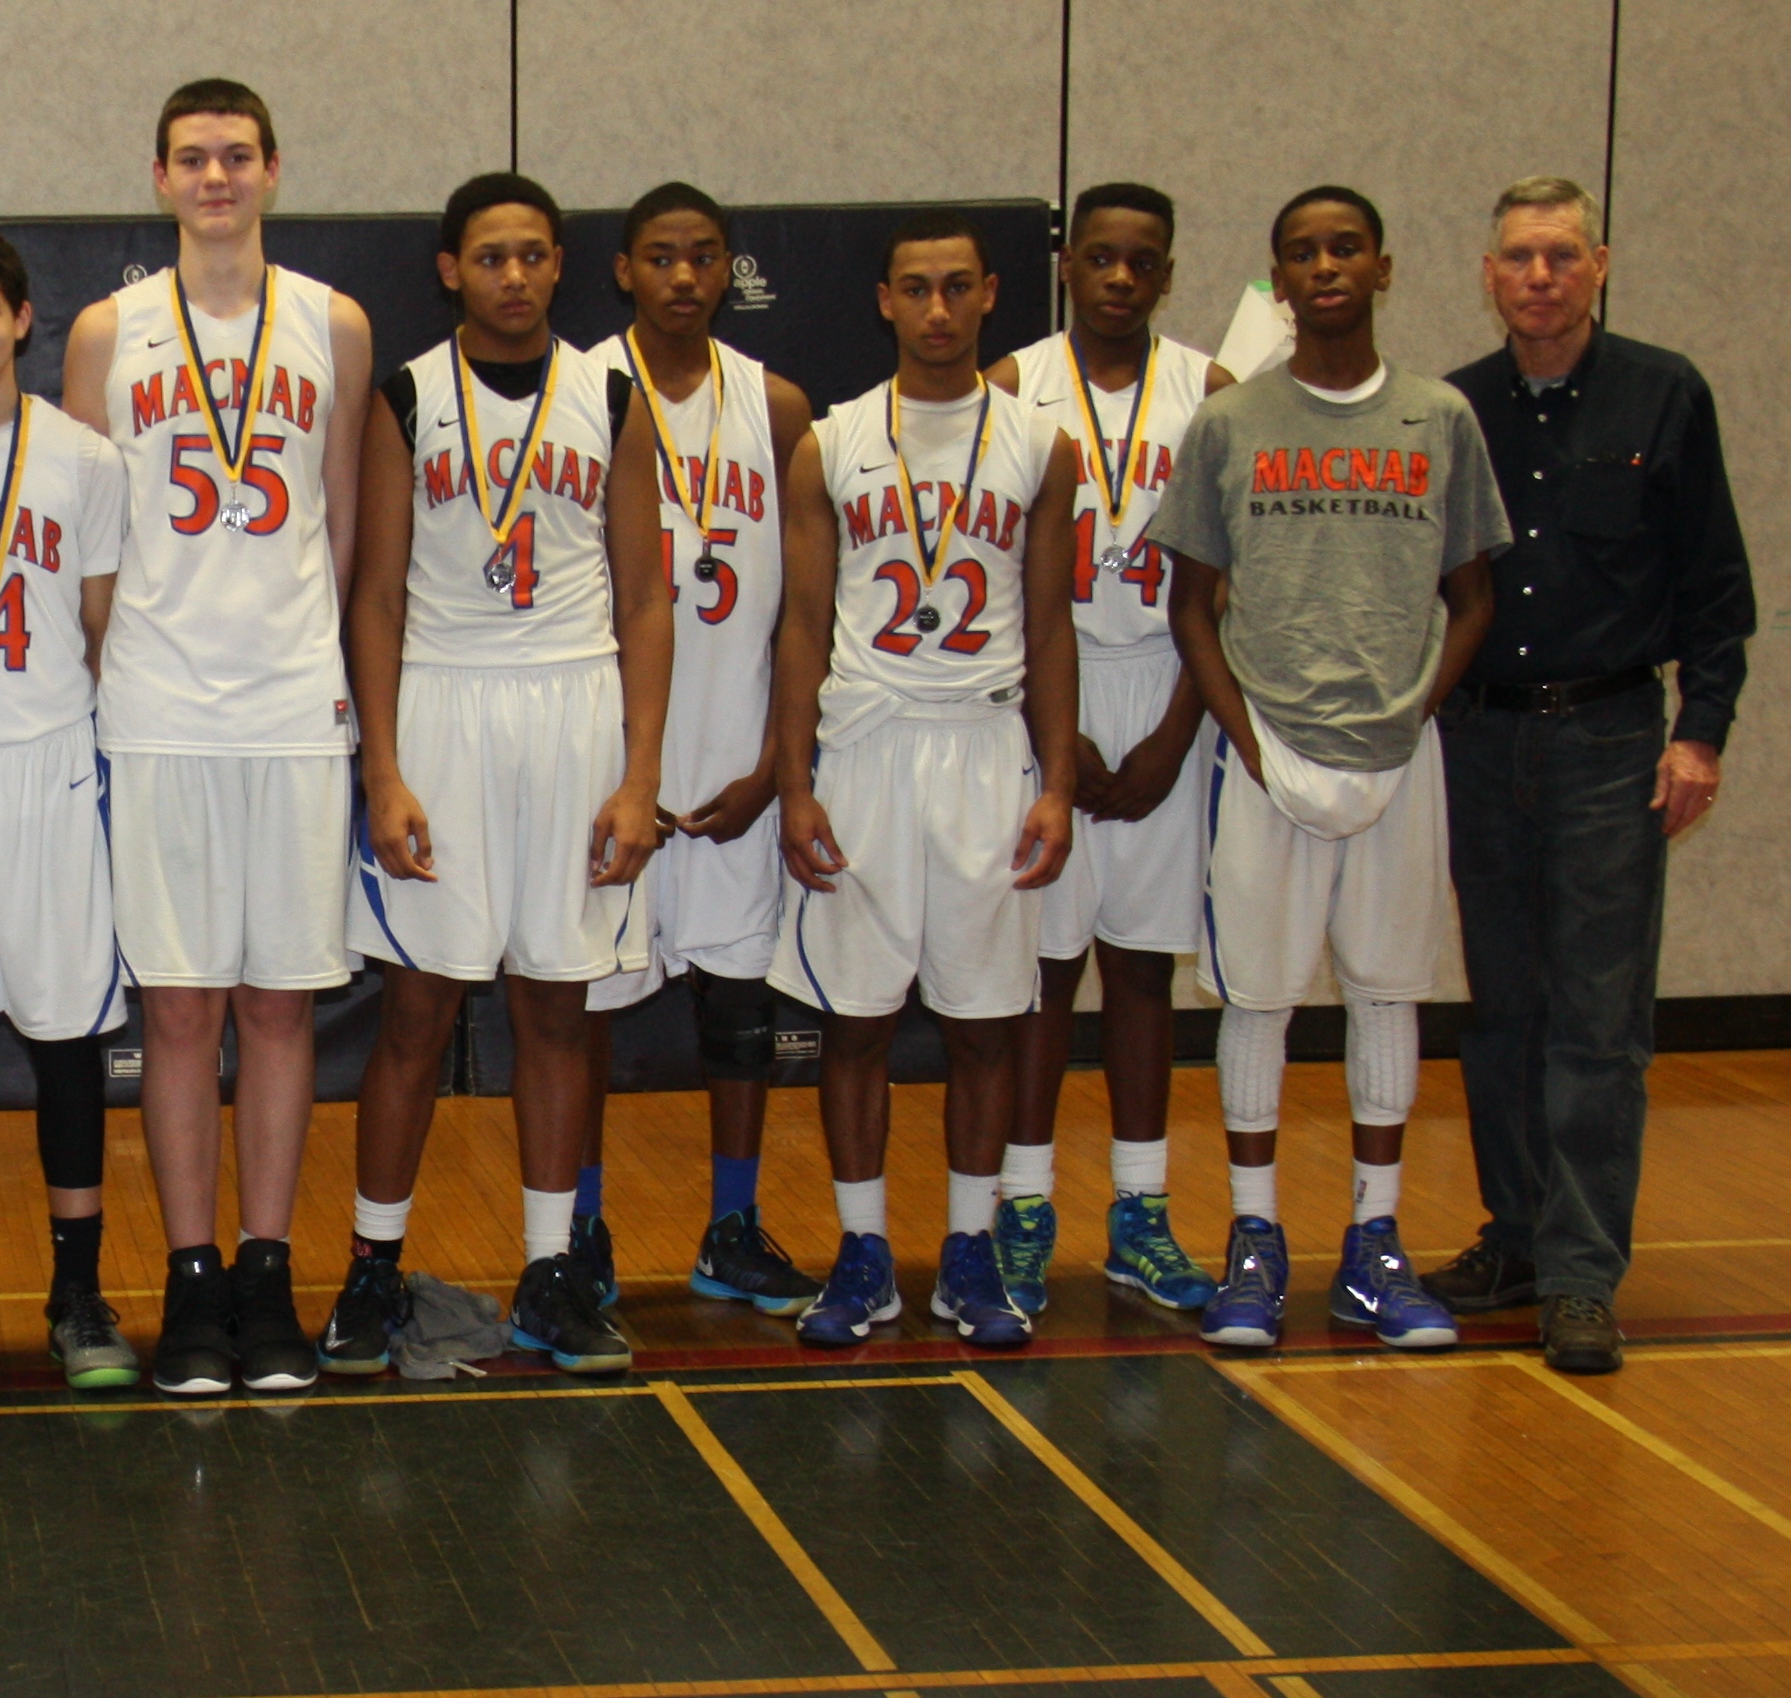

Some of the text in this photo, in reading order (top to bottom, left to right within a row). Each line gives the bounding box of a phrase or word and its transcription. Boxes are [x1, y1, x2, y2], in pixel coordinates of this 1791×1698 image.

[169, 434, 289, 536] 55
[1250, 499, 1430, 521] BASKETBALL
[1252, 447, 1430, 497] MACNAB
[483, 511, 540, 609] 4
[872, 558, 991, 657] 22
